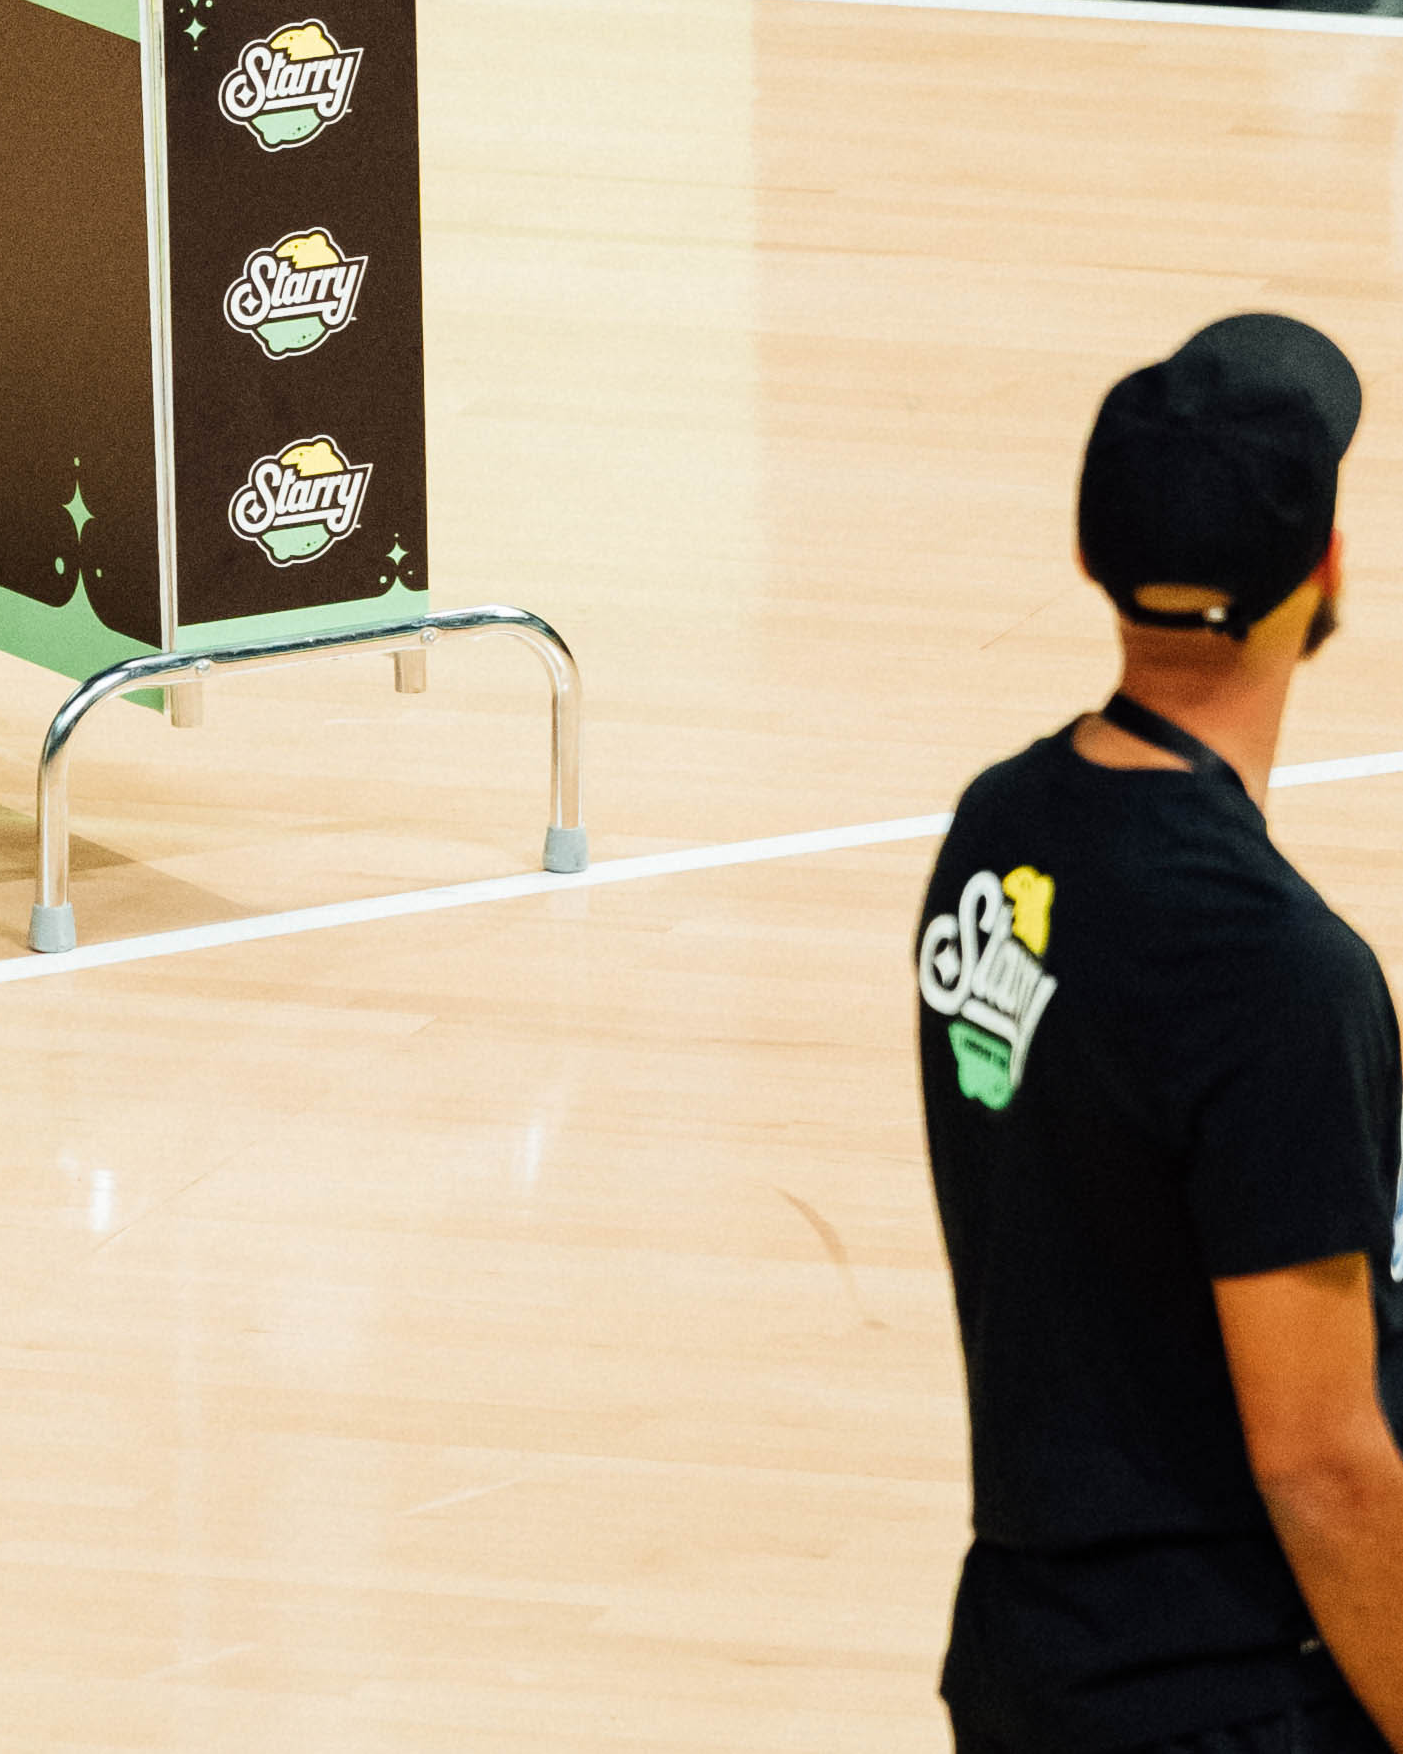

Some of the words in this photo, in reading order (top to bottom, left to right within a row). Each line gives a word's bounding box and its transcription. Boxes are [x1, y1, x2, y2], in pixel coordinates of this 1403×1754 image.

[221, 46, 355, 118] Starry
[226, 254, 360, 326] Starry
[230, 462, 364, 534] Starry
[918, 869, 1060, 1093] Starry
